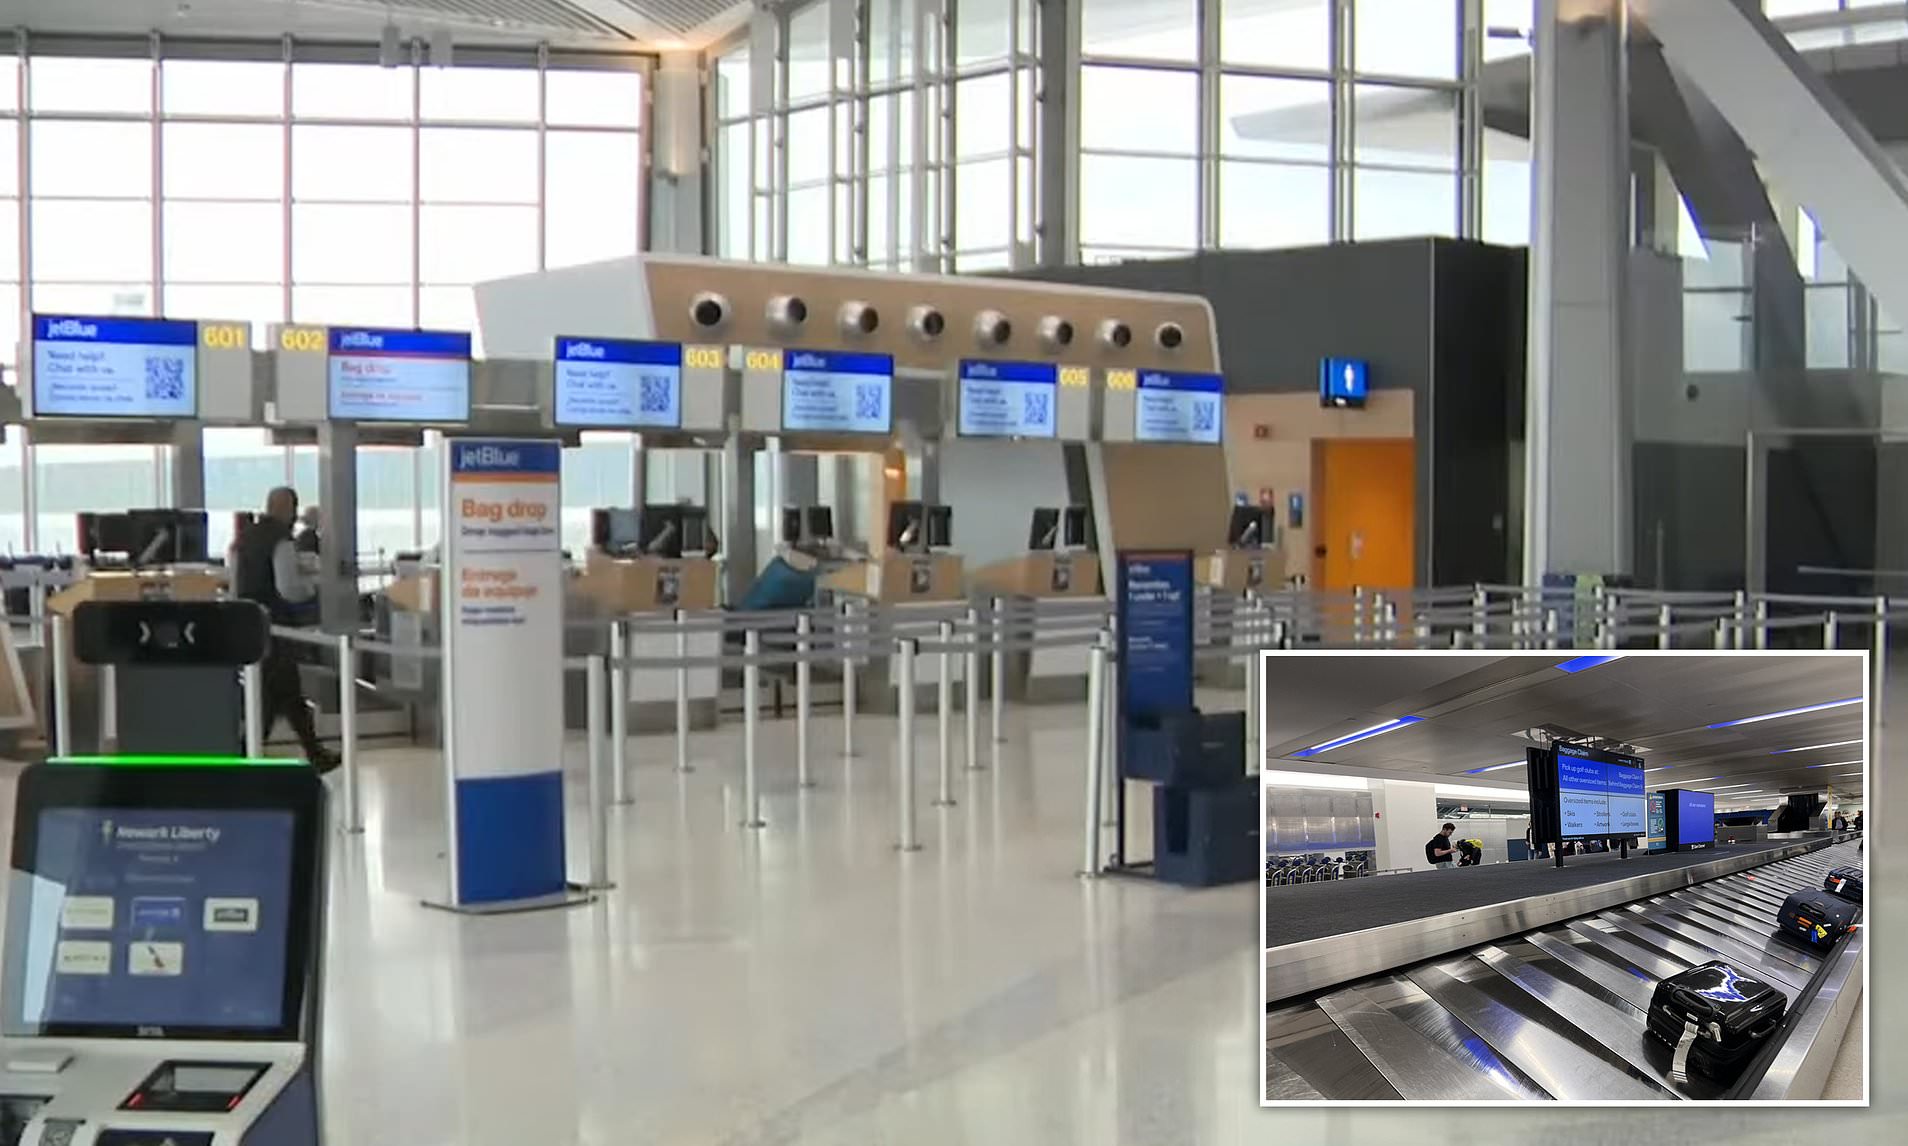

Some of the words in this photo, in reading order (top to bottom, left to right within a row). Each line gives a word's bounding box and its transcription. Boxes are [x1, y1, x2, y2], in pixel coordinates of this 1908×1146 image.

[48, 319, 97, 338] jetBlue
[204, 326, 244, 348] 601
[281, 328, 324, 350] 602
[685, 348, 721, 368] 603
[746, 351, 780, 369] 604
[460, 445, 520, 468] jetBlue
[462, 499, 502, 523] Bag
[507, 498, 547, 522] drop
[1559, 745, 1577, 755] Baggage
[1578, 748, 1589, 757] Claim
[1562, 763, 1571, 771] Pick
[117, 826, 169, 839] Newark
[170, 826, 221, 845] Liberty
